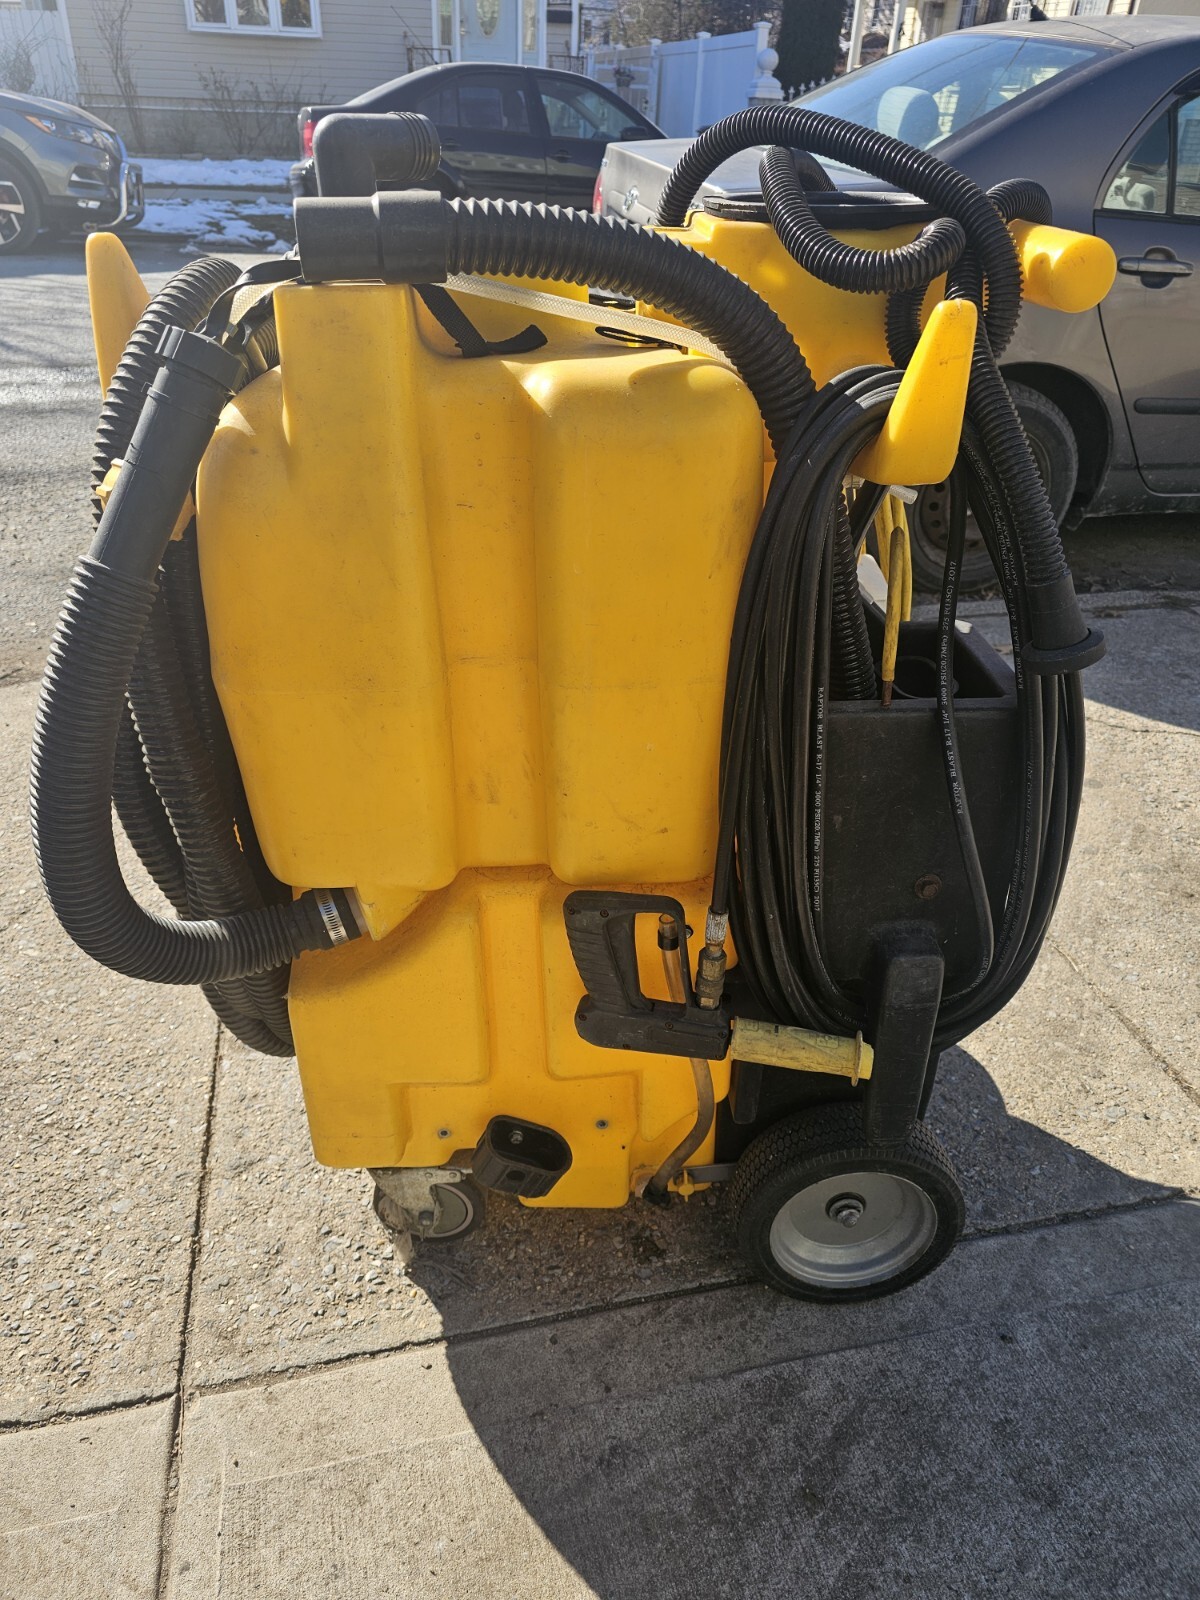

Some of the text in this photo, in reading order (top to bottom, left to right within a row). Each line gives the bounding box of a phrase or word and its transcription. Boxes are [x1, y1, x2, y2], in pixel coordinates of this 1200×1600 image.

[948, 561, 957, 581] 2017
[942, 616, 950, 631] 275
[817, 687, 825, 720] RAPTOR
[940, 687, 948, 706] 3000
[944, 728, 952, 746] R-17
[815, 754, 823, 770] R-17
[946, 750, 957, 778] BLAST
[952, 781, 963, 814] RAPTOR
